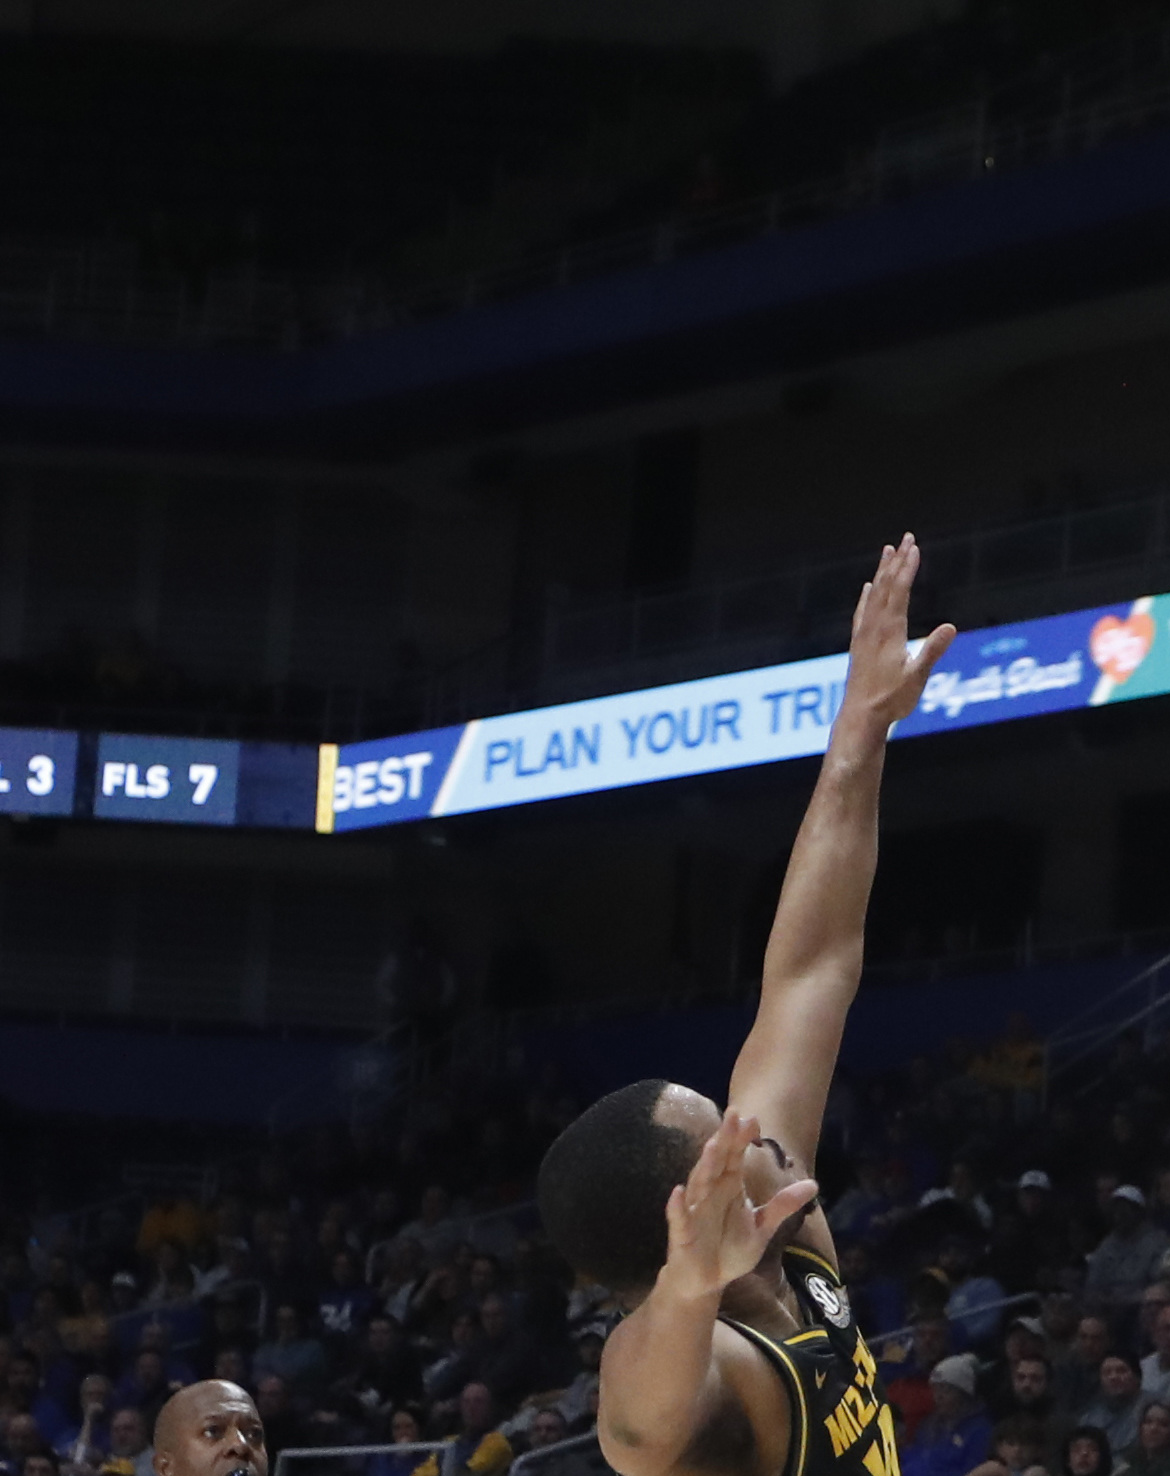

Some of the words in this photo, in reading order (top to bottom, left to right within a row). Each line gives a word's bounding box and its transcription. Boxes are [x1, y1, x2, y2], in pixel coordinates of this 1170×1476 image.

[484, 732, 598, 783] PLAN
[620, 700, 742, 757] YOUR
[762, 681, 847, 734] TRI
[26, 755, 54, 796] 3
[102, 762, 169, 799] FLS
[188, 764, 218, 804] 7
[333, 751, 433, 813] BEST
